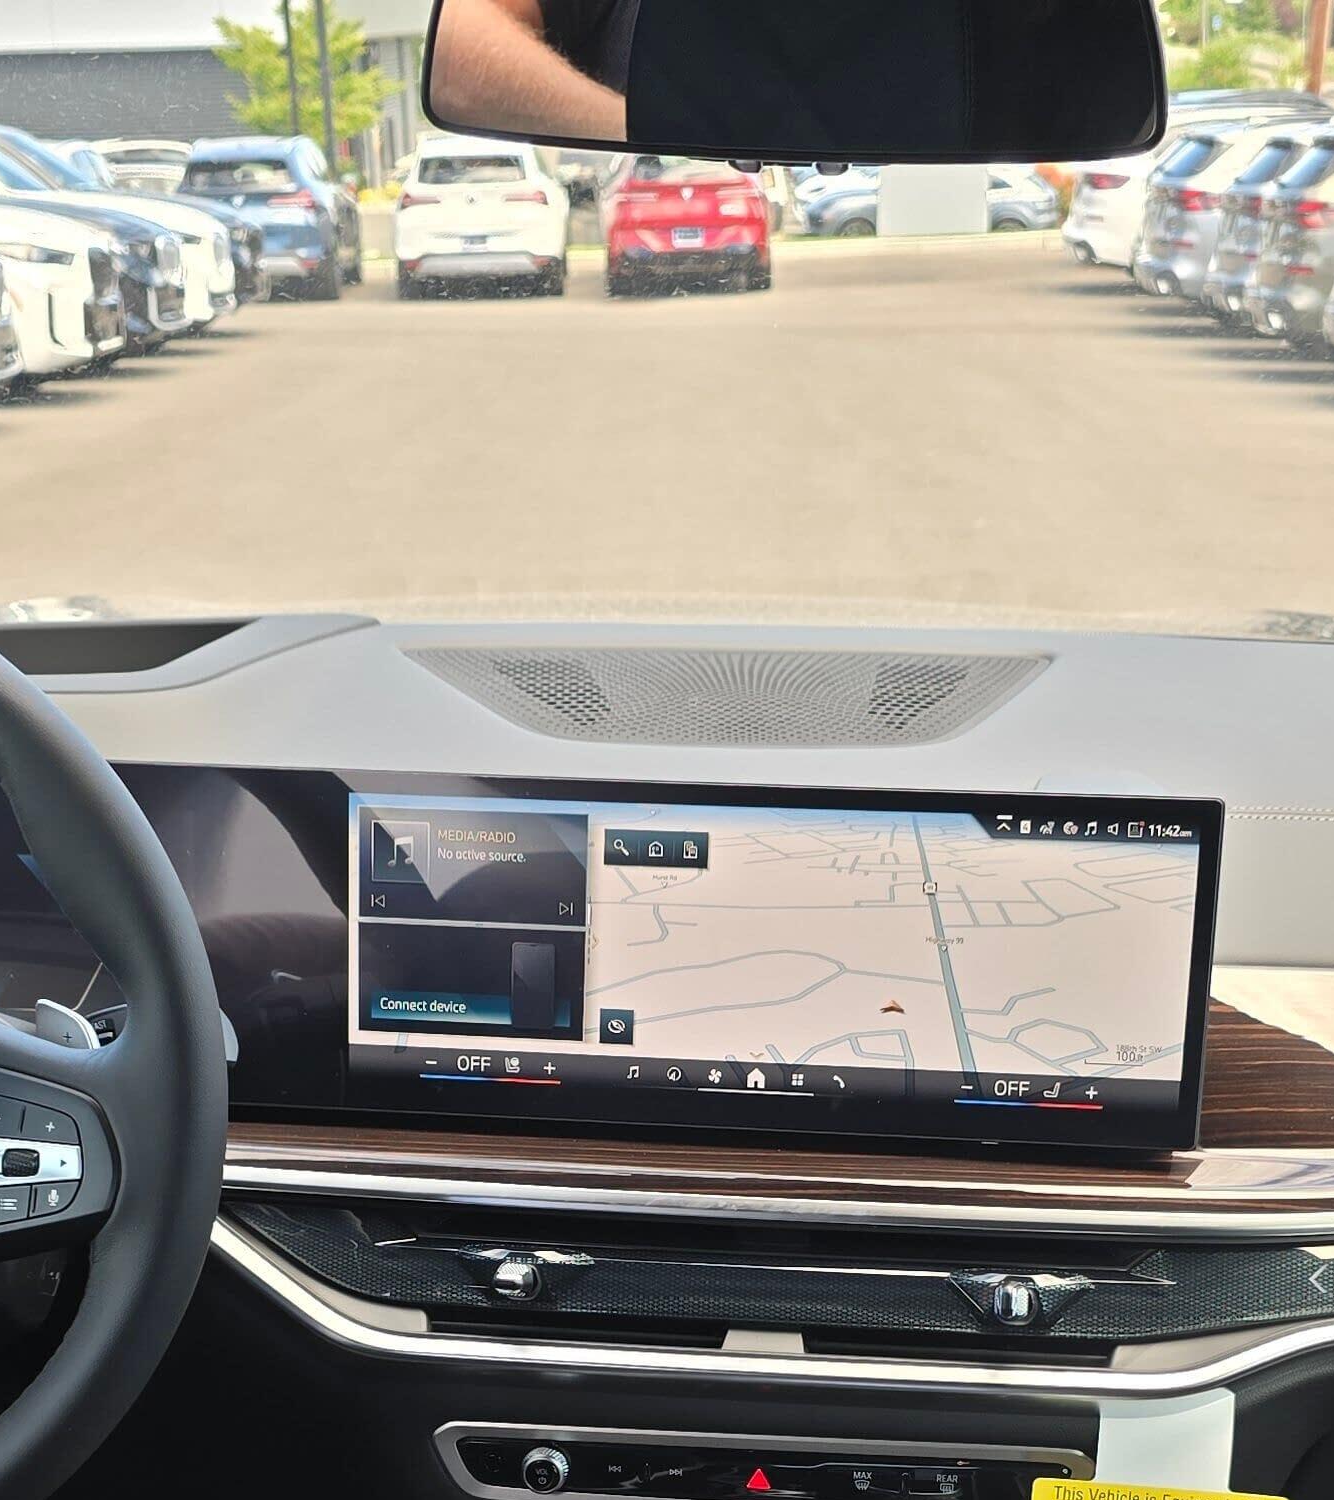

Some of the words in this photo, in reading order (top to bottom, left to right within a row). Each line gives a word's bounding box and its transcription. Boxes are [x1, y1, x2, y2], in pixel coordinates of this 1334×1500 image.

[437, 829, 516, 844] MEDIA/RADIO
[437, 847, 453, 860] No
[455, 849, 487, 862] active
[488, 851, 527, 863] source.
[379, 997, 428, 1012] Connect
[429, 1000, 467, 1014] device
[457, 1055, 492, 1073] OFF
[994, 1080, 1030, 1097] OFF
[853, 1471, 873, 1480] MAX
[936, 1474, 959, 1483] REAR
[1054, 1485, 1084, 1500] This
